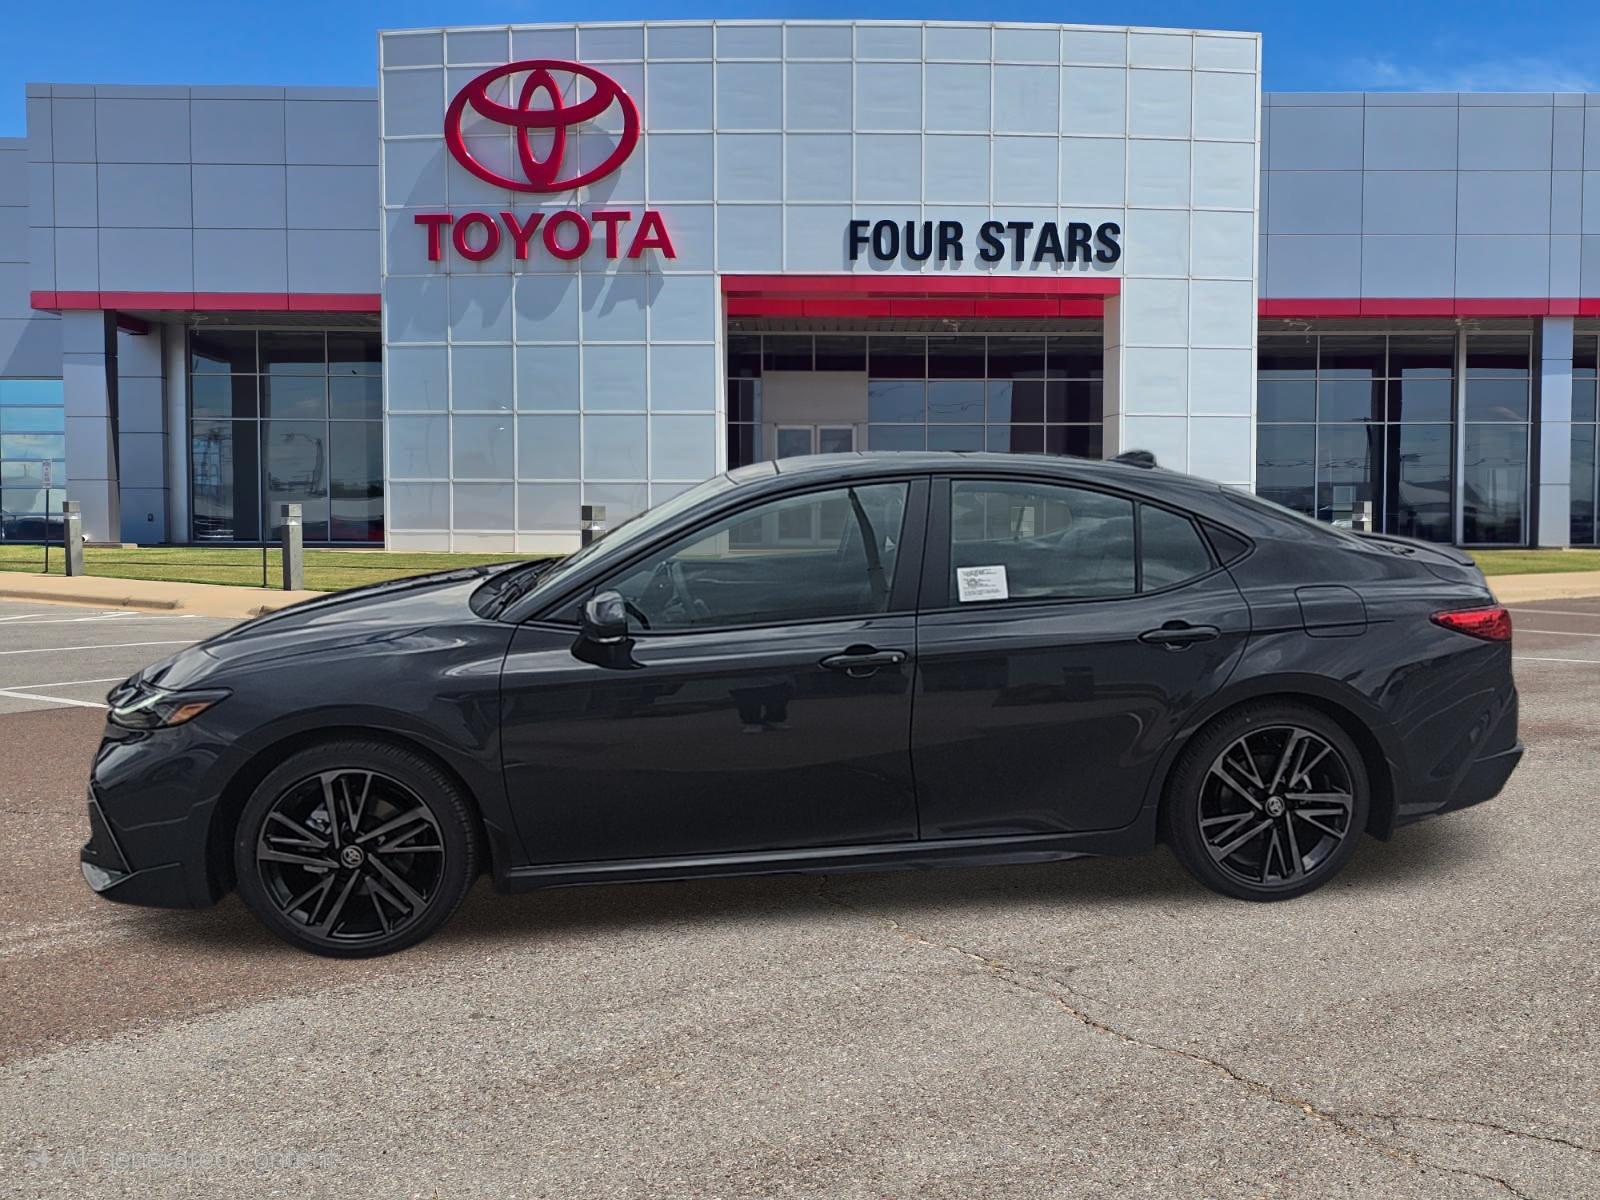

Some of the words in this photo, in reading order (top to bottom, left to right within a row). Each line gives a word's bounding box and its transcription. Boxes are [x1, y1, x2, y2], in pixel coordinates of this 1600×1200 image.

[414, 210, 677, 261] TOYOTA
[849, 219, 964, 261] FOUR
[979, 220, 1121, 263] STARS
